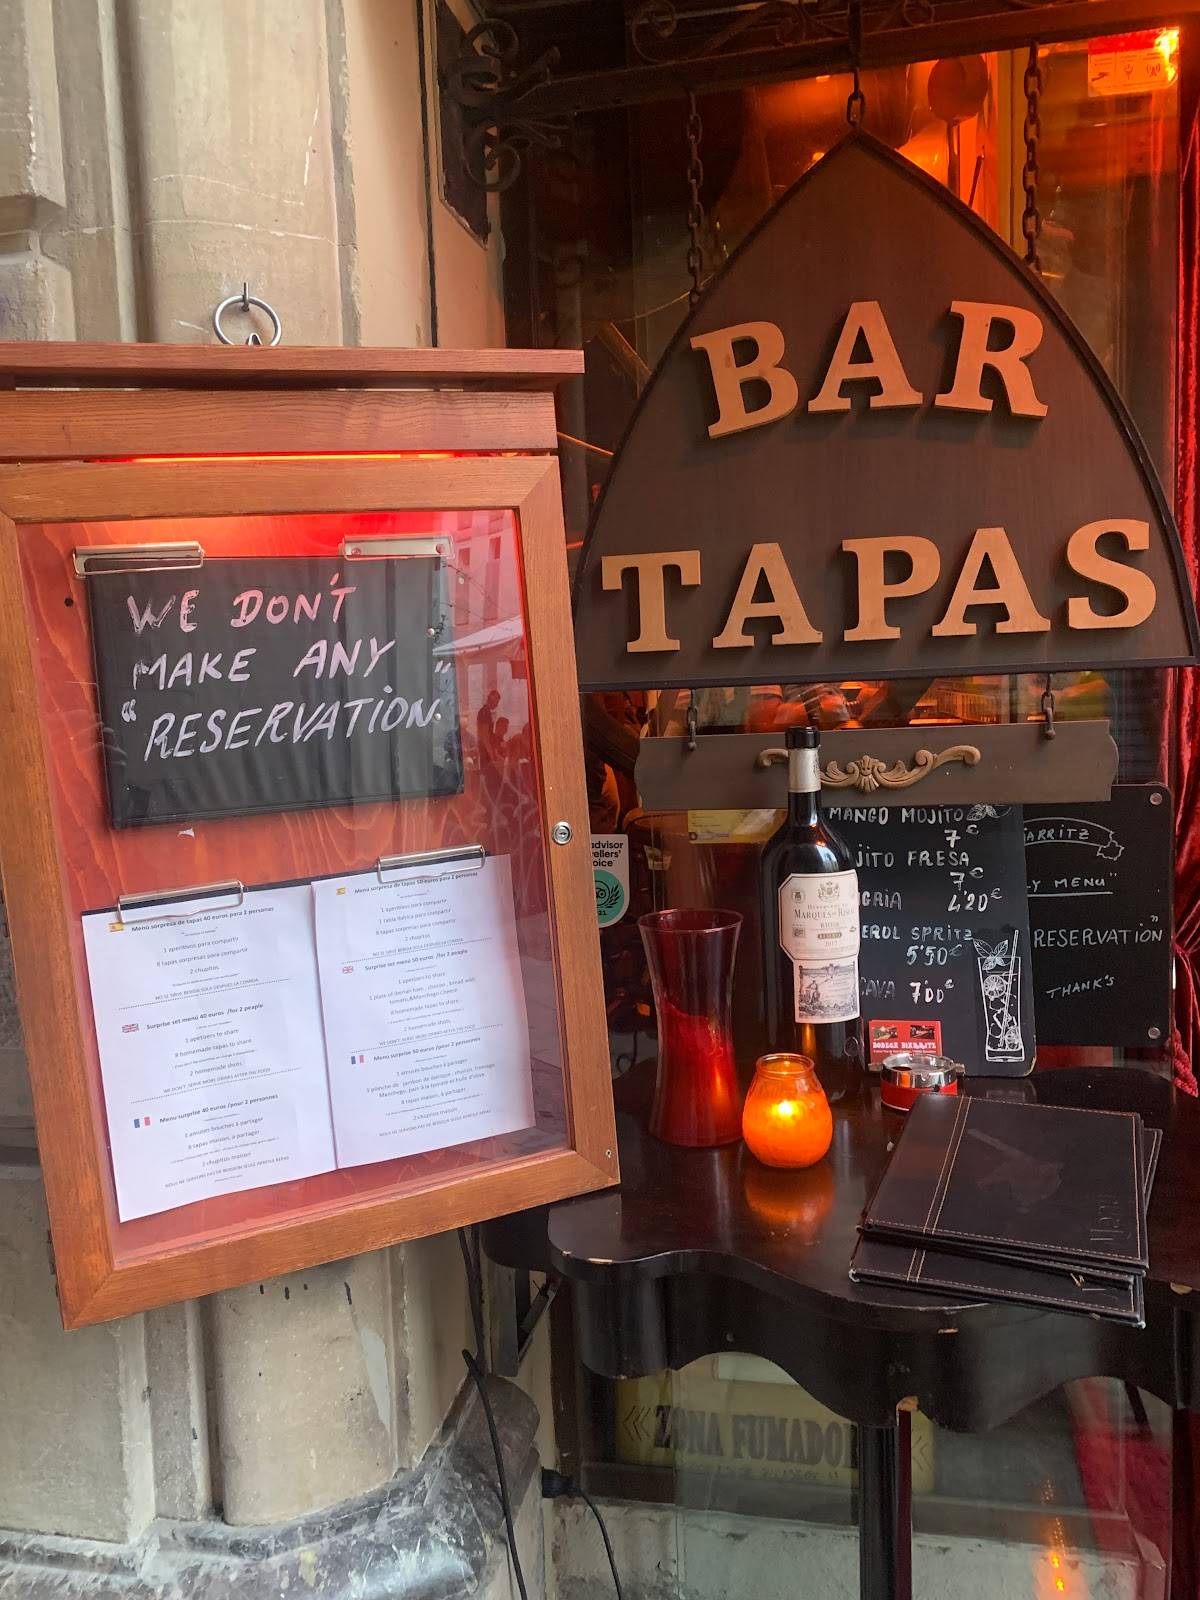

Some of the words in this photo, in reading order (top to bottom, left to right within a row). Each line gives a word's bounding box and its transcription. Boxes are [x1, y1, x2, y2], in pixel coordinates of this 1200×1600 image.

[690, 300, 1048, 438] BAR
[127, 589, 199, 634] WE
[230, 573, 357, 628] DON'T
[602, 519, 1156, 653] TAPAS
[132, 648, 257, 691] MAKE
[293, 636, 396, 680] ANY
[829, 806, 889, 825] MANGO
[901, 805, 964, 825] MOJITO
[592, 850, 622, 858] ellers'
[907, 850, 970, 867] FRESA
[911, 924, 973, 941] SPRITZ
[655, 1404, 724, 1457] ZONA
